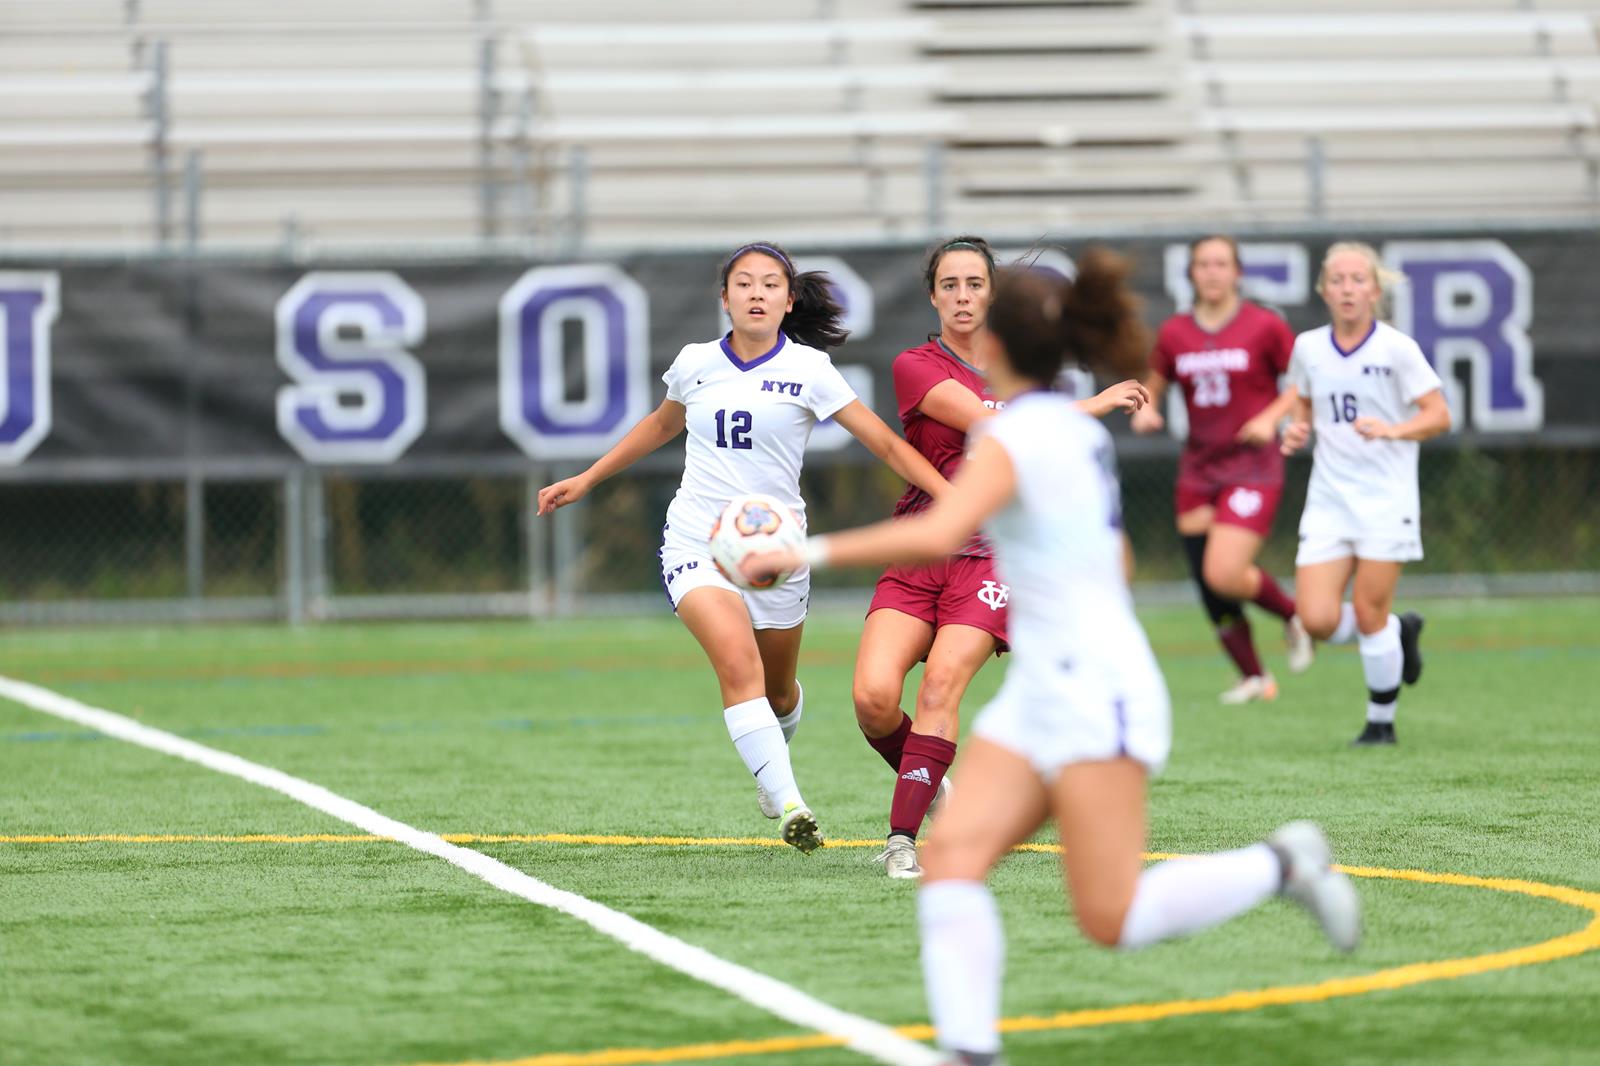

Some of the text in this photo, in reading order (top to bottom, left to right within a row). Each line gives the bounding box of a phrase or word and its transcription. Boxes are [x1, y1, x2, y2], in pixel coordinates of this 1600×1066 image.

[275, 240, 1545, 464] SOR
[761, 380, 803, 397] NYU
[1330, 393, 1357, 423] 16
[715, 409, 753, 450] 12
[666, 560, 699, 585] NYU
